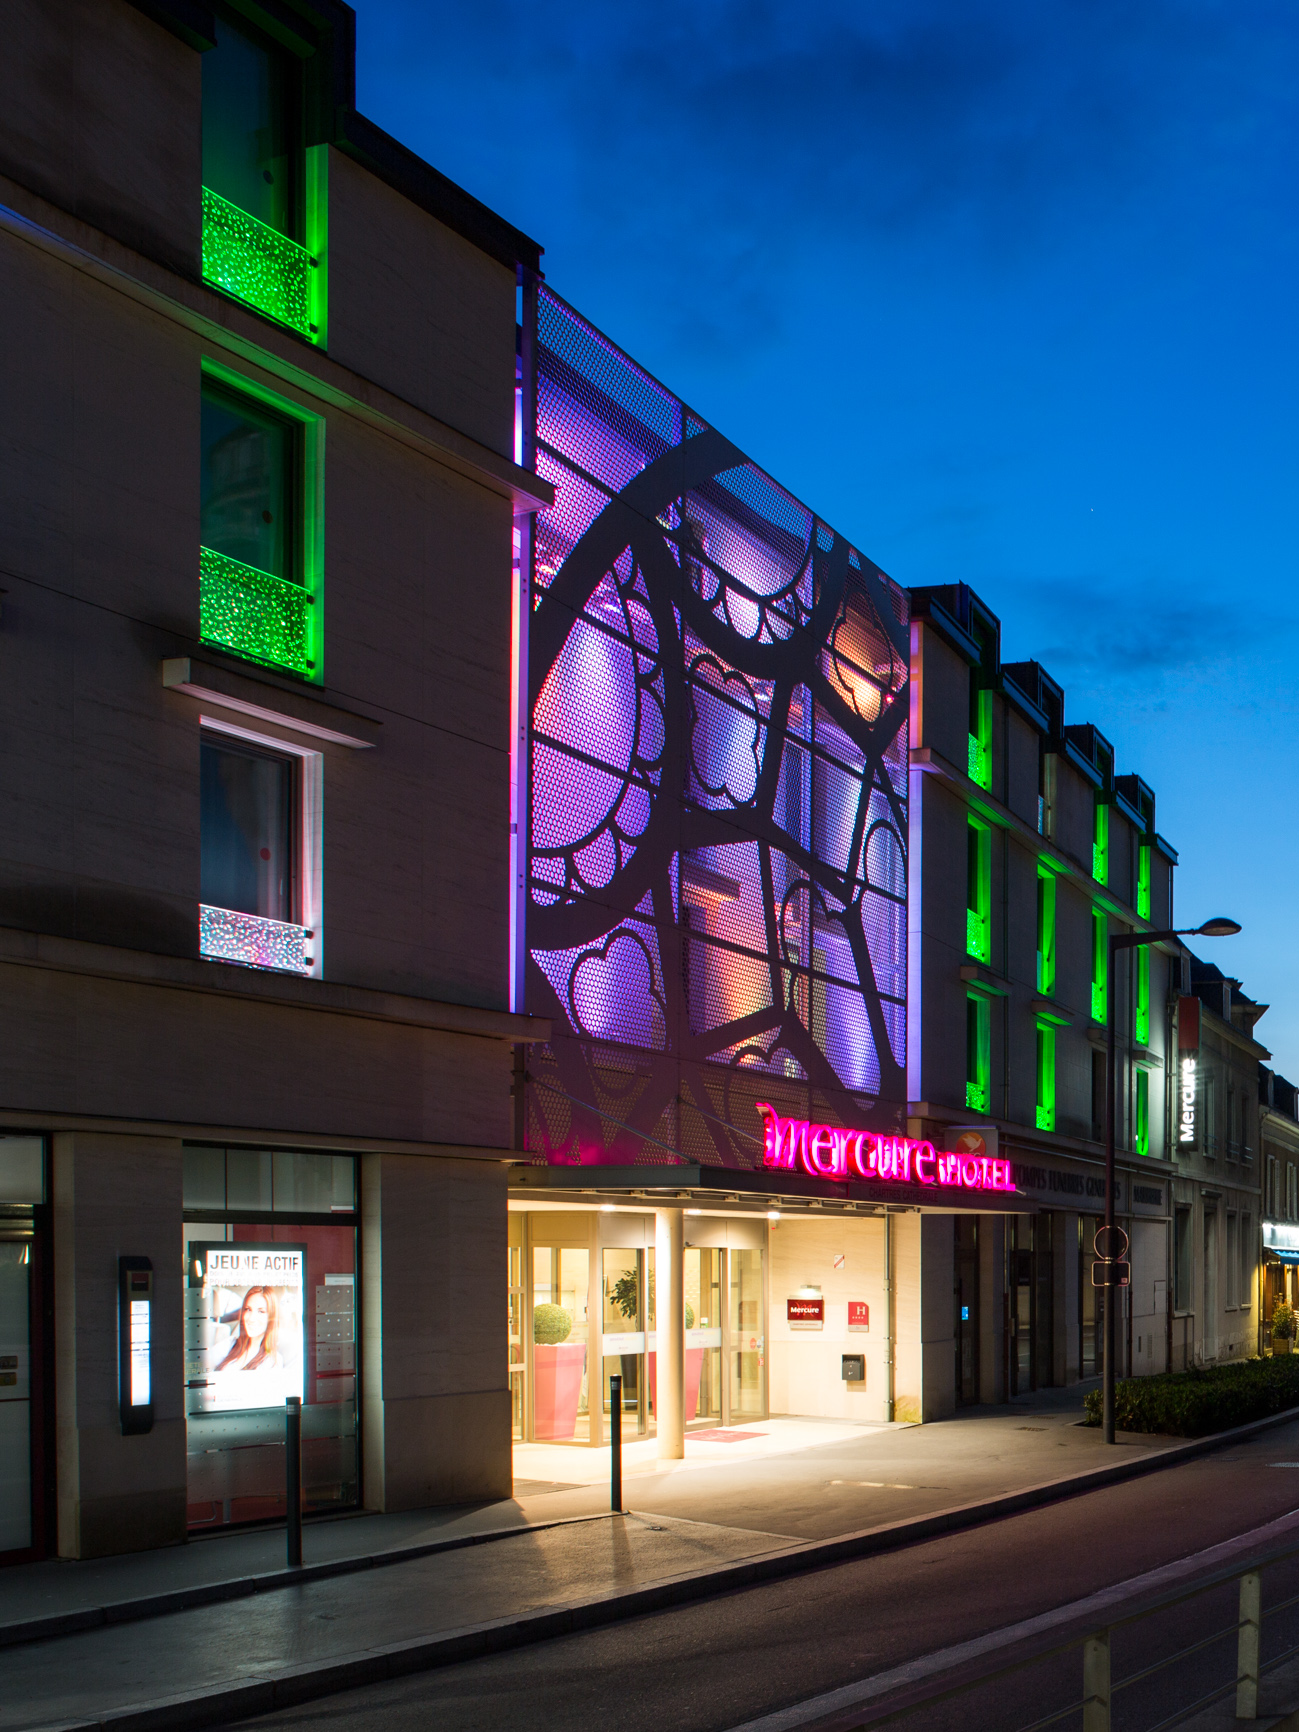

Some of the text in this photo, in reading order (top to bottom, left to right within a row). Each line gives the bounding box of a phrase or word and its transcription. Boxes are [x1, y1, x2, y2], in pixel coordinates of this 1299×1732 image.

[1180, 1058, 1196, 1142] Mercure
[868, 1186, 902, 1201] CHARTRES
[210, 1255, 299, 1271] JEUNE ACTIF
[790, 1306, 820, 1315] Mercure
[857, 1306, 866, 1315] H
